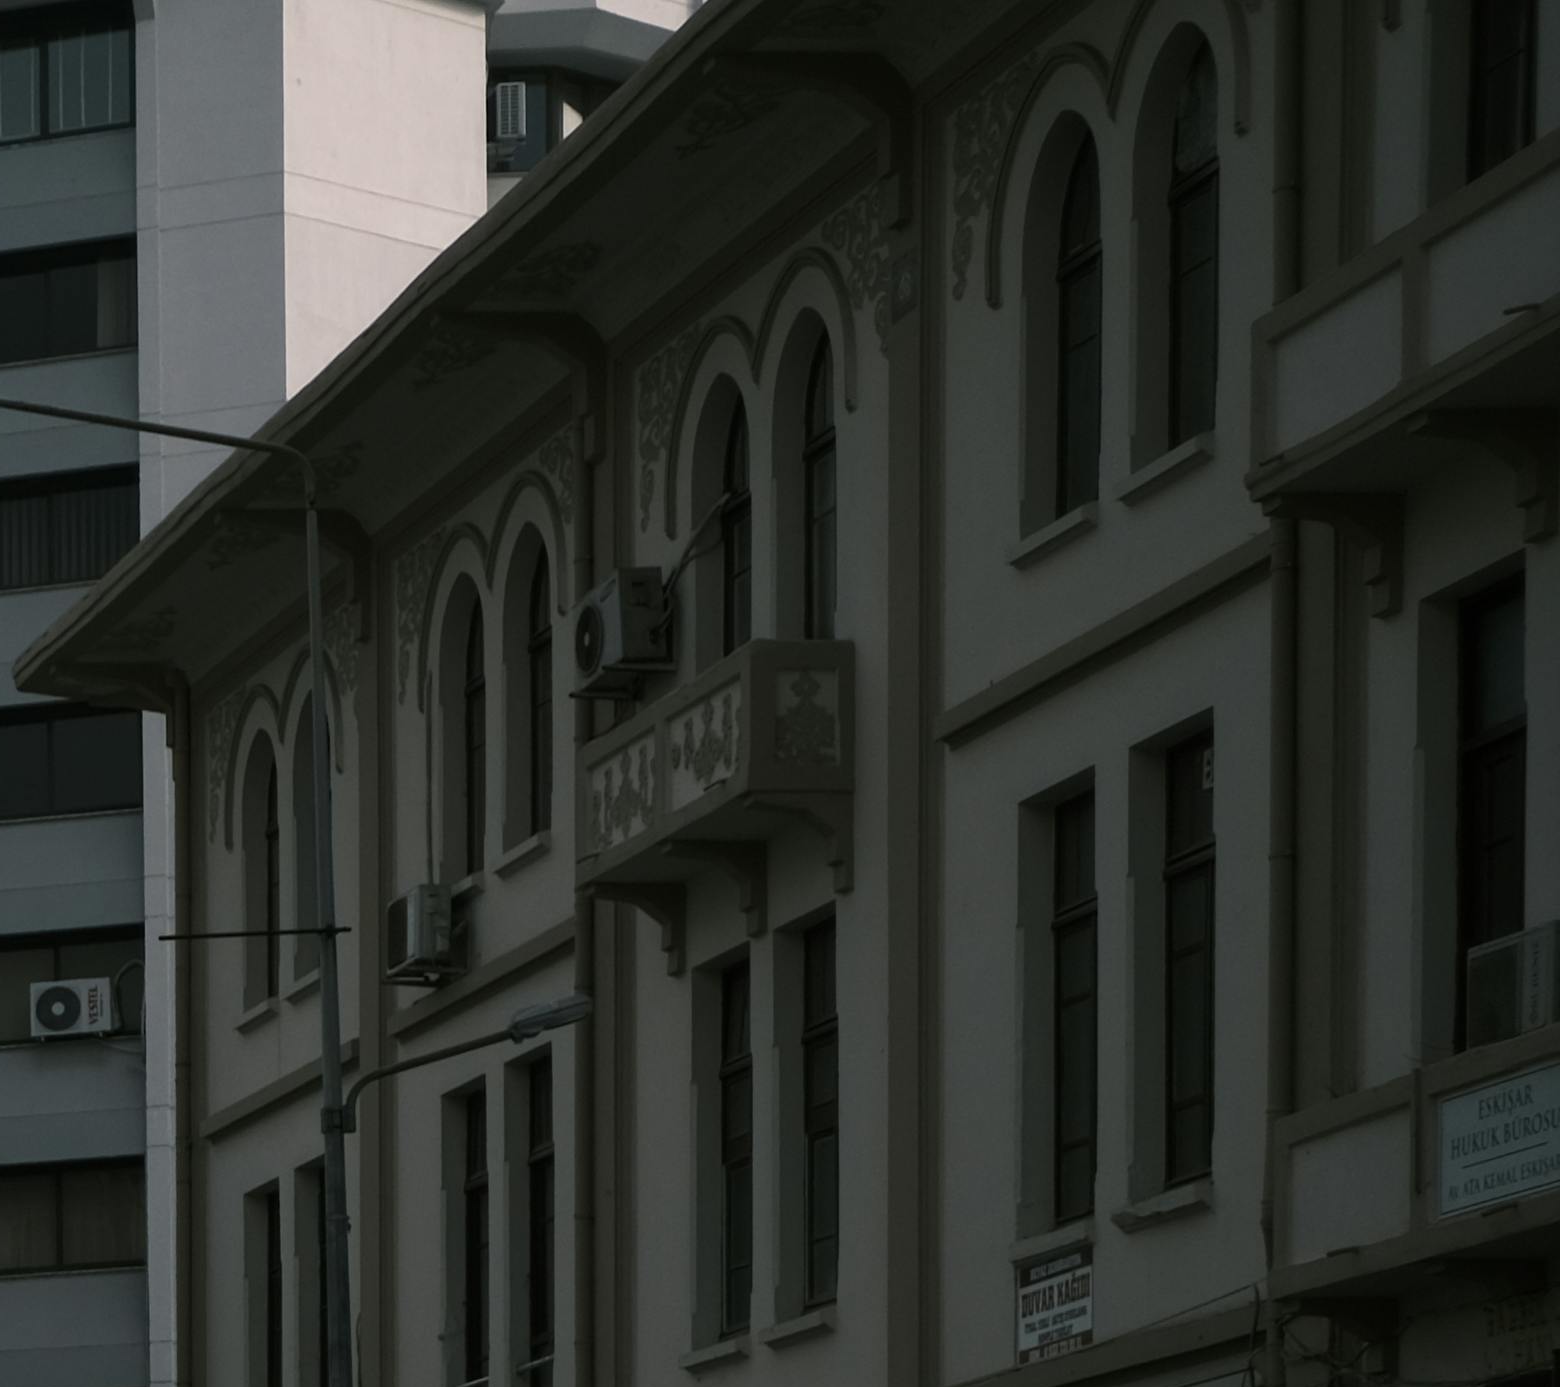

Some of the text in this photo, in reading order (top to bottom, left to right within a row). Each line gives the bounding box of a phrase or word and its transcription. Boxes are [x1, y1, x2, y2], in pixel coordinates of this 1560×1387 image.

[1478, 1084, 1534, 1120] ESKİŞAR
[1450, 1127, 1500, 1160] HUKUK
[1483, 1167, 1518, 1191] KEMAL
[1022, 1285, 1055, 1318] DUVAR
